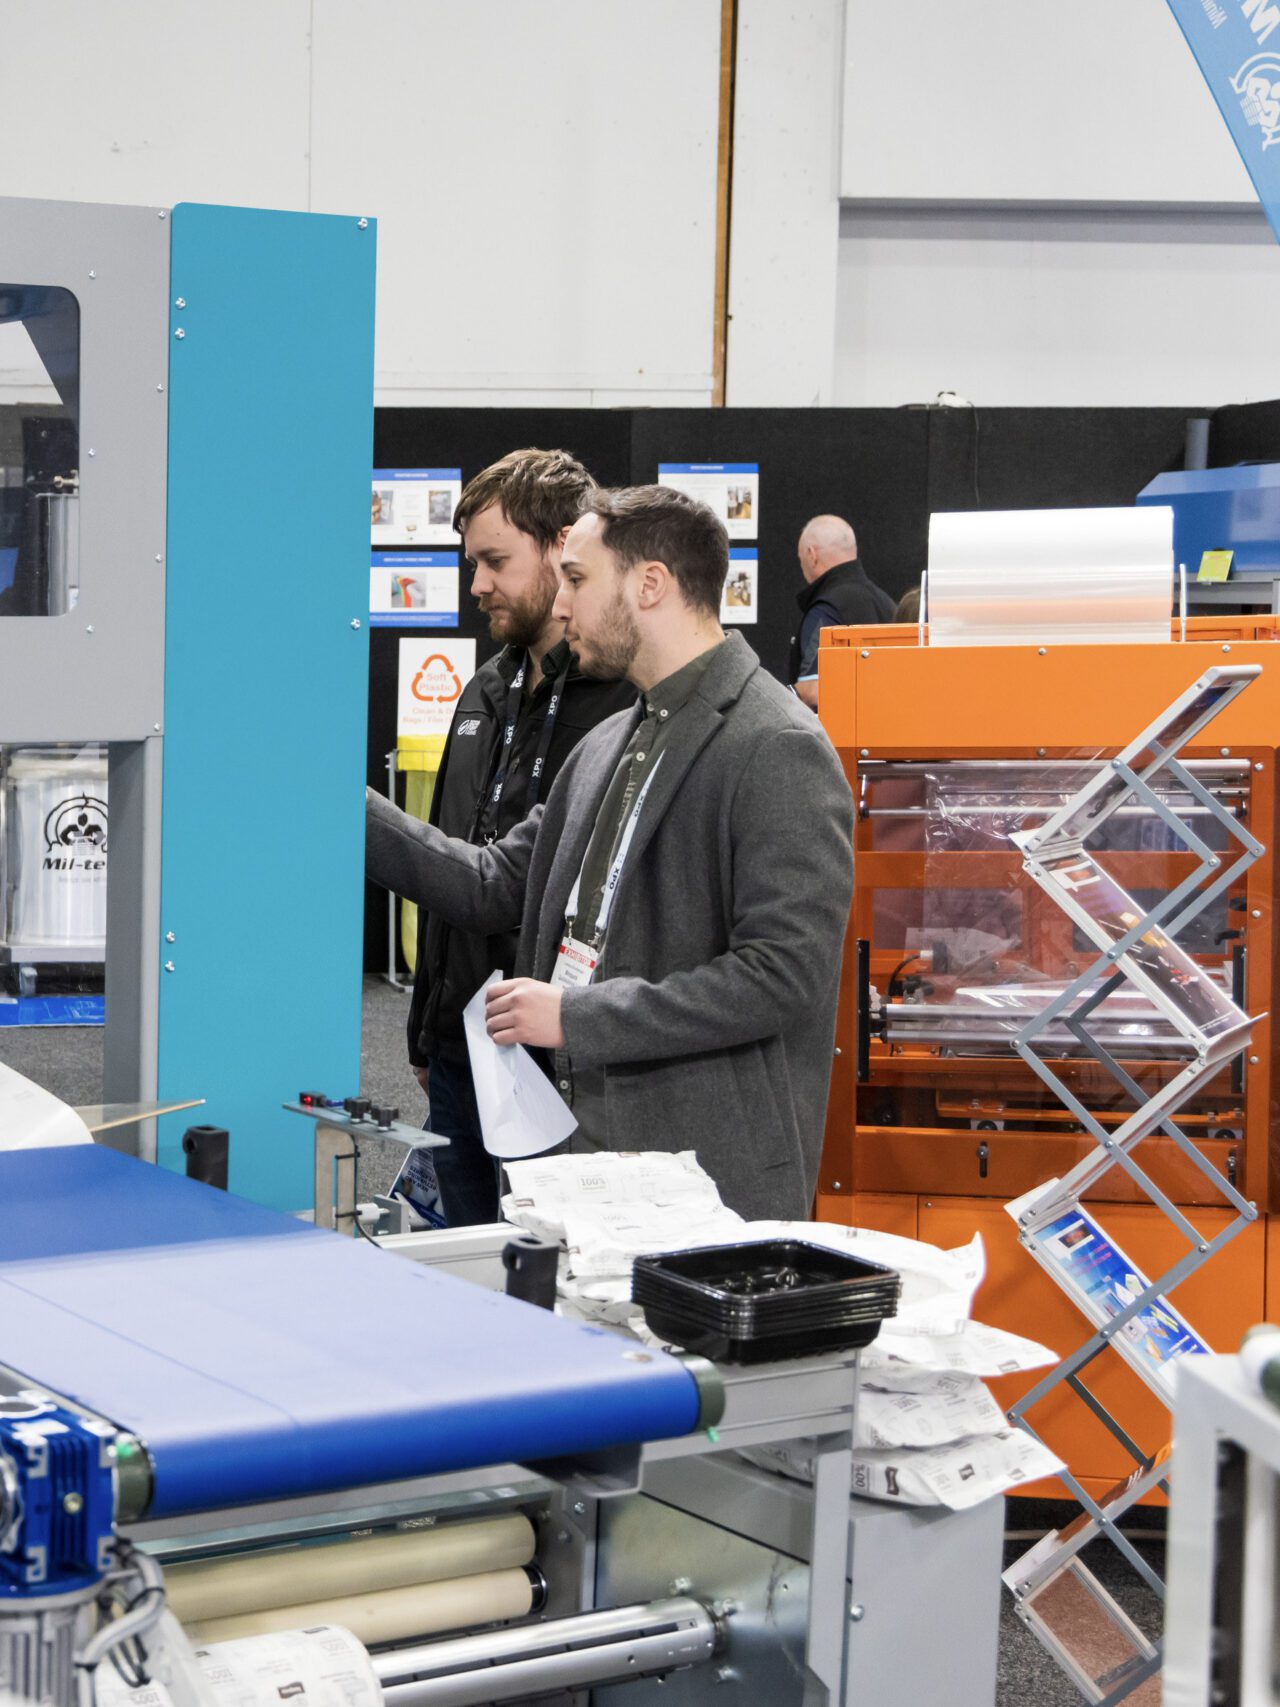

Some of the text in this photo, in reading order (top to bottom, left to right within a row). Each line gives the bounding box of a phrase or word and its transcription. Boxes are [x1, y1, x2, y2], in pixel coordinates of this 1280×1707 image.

[426, 673, 446, 681] Soft
[419, 683, 452, 692] Plastic
[548, 695, 558, 715] XPO
[505, 725, 515, 744] XPO
[532, 757, 542, 777] XPO
[609, 867, 620, 890] XPO
[580, 1177, 606, 1187] 100%
[855, 1463, 866, 1488] 00%
